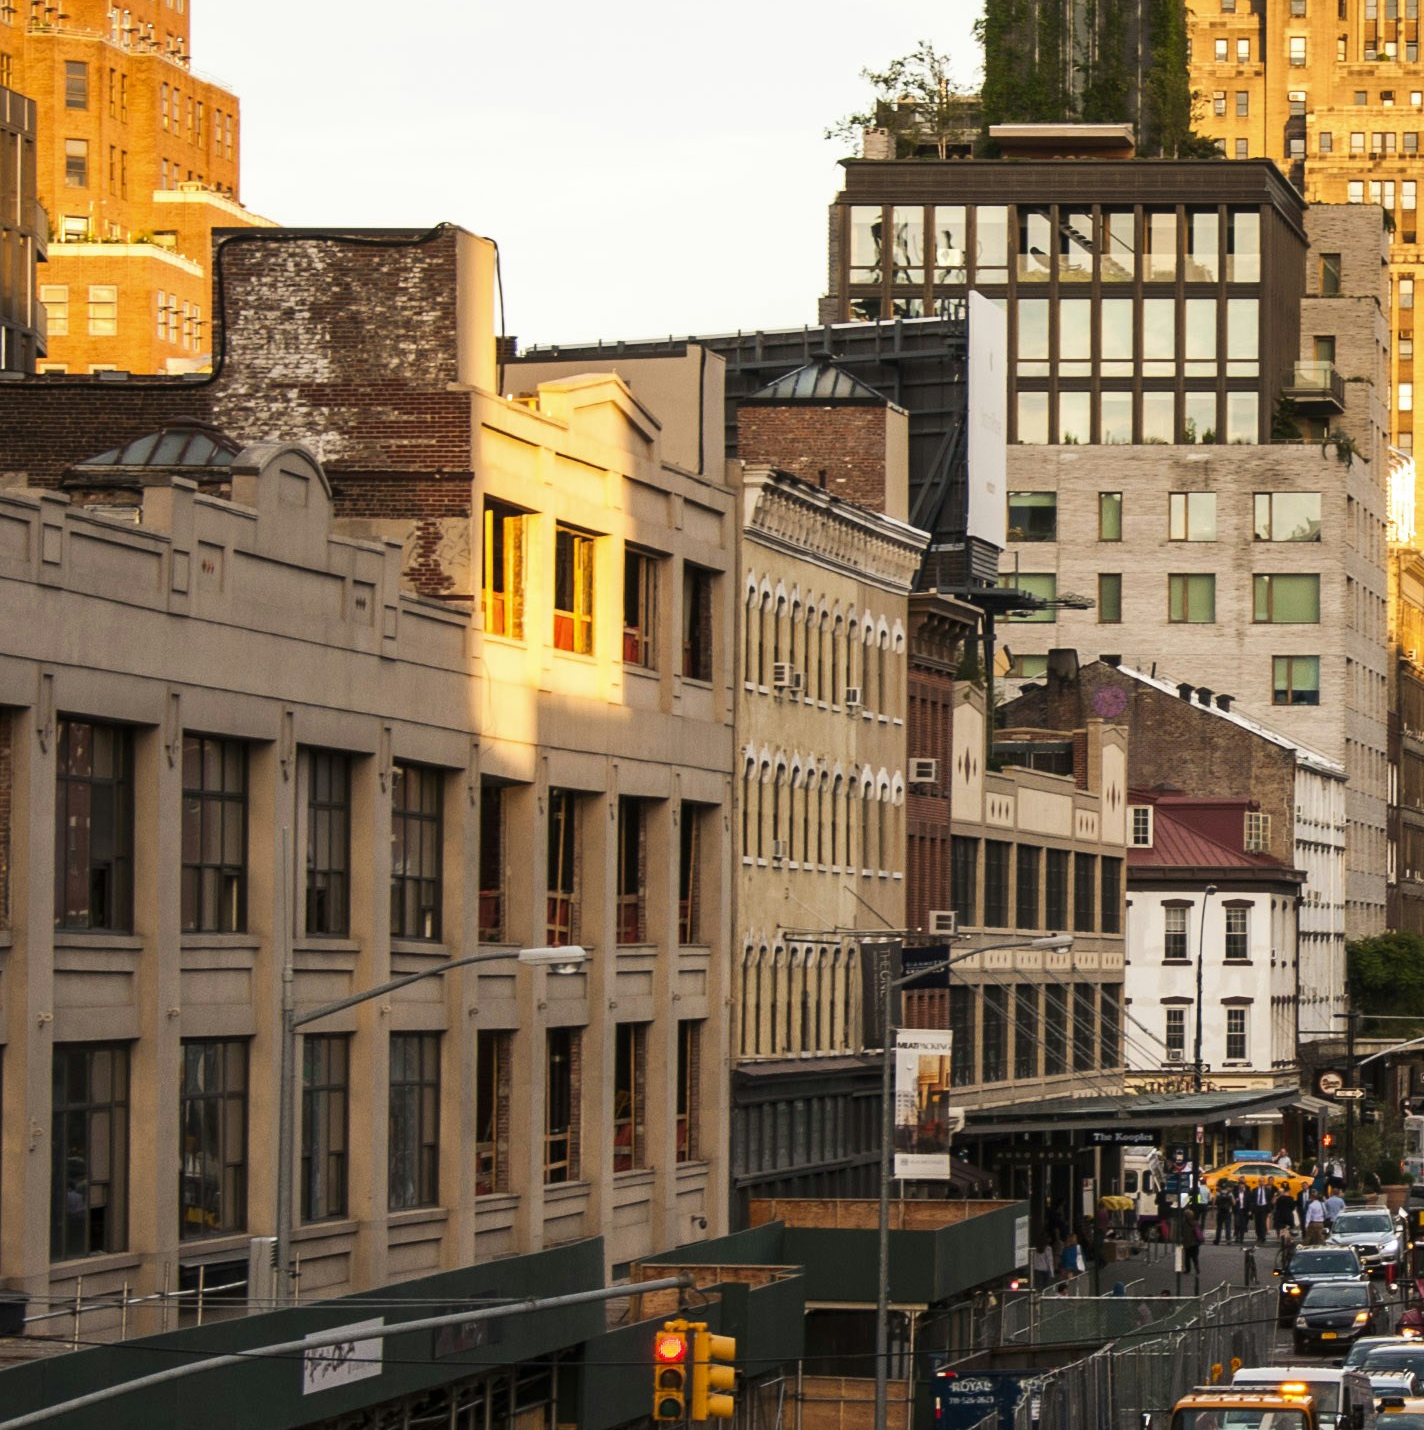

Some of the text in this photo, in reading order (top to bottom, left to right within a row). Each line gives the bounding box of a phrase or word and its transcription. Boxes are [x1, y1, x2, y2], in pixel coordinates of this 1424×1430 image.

[1093, 1132, 1154, 1143] The Kooples
[951, 1379, 992, 1392] ROYAL
